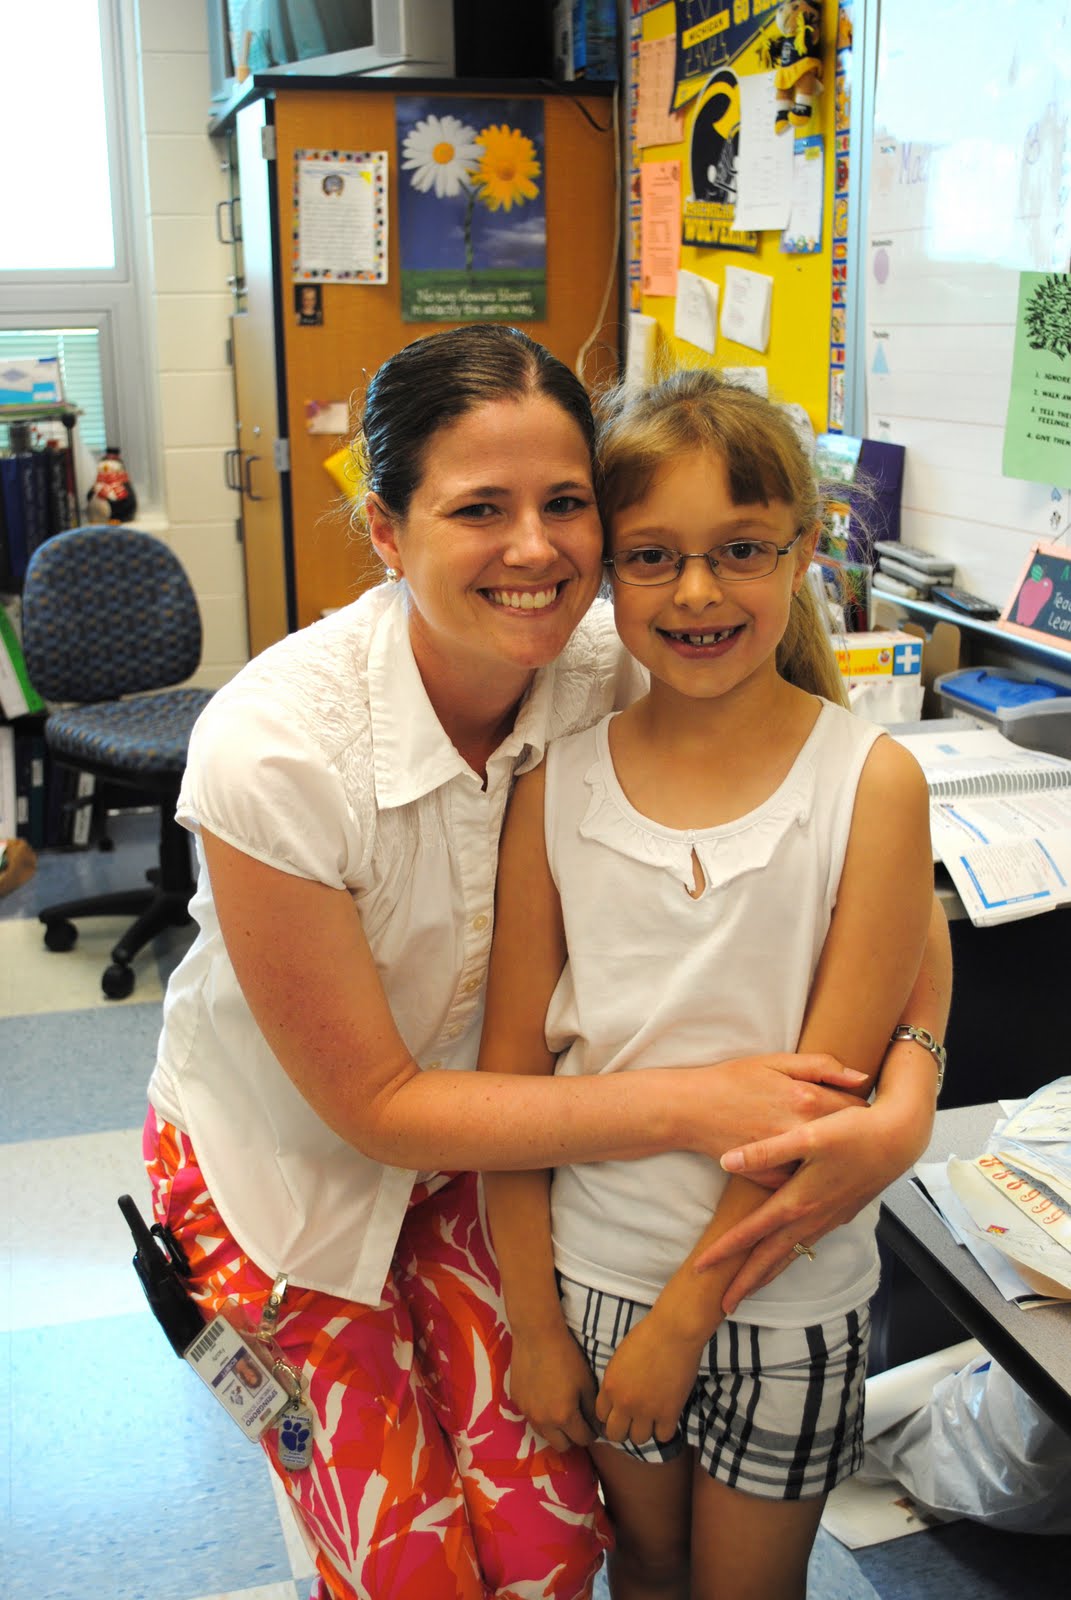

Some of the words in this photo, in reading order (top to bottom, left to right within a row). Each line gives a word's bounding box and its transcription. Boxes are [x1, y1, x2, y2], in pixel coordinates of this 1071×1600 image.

[688, 17, 724, 41] MICHIGAN
[416, 288, 434, 302] No
[435, 290, 457, 302] two
[458, 288, 497, 302] flowers
[498, 288, 532, 302] bloom
[424, 303, 462, 317] exactly
[463, 303, 482, 315] the
[482, 304, 510, 315] same
[1045, 373, 1071, 384] IGNORE
[1042, 391, 1059, 399] WALK
[1040, 407, 1055, 417] TELL
[1037, 416, 1070, 428] FEELINGS
[1035, 433, 1051, 443] GIVE
[1053, 437, 1071, 447] THEM
[245, 1389, 278, 1427] SPRINGBORO
